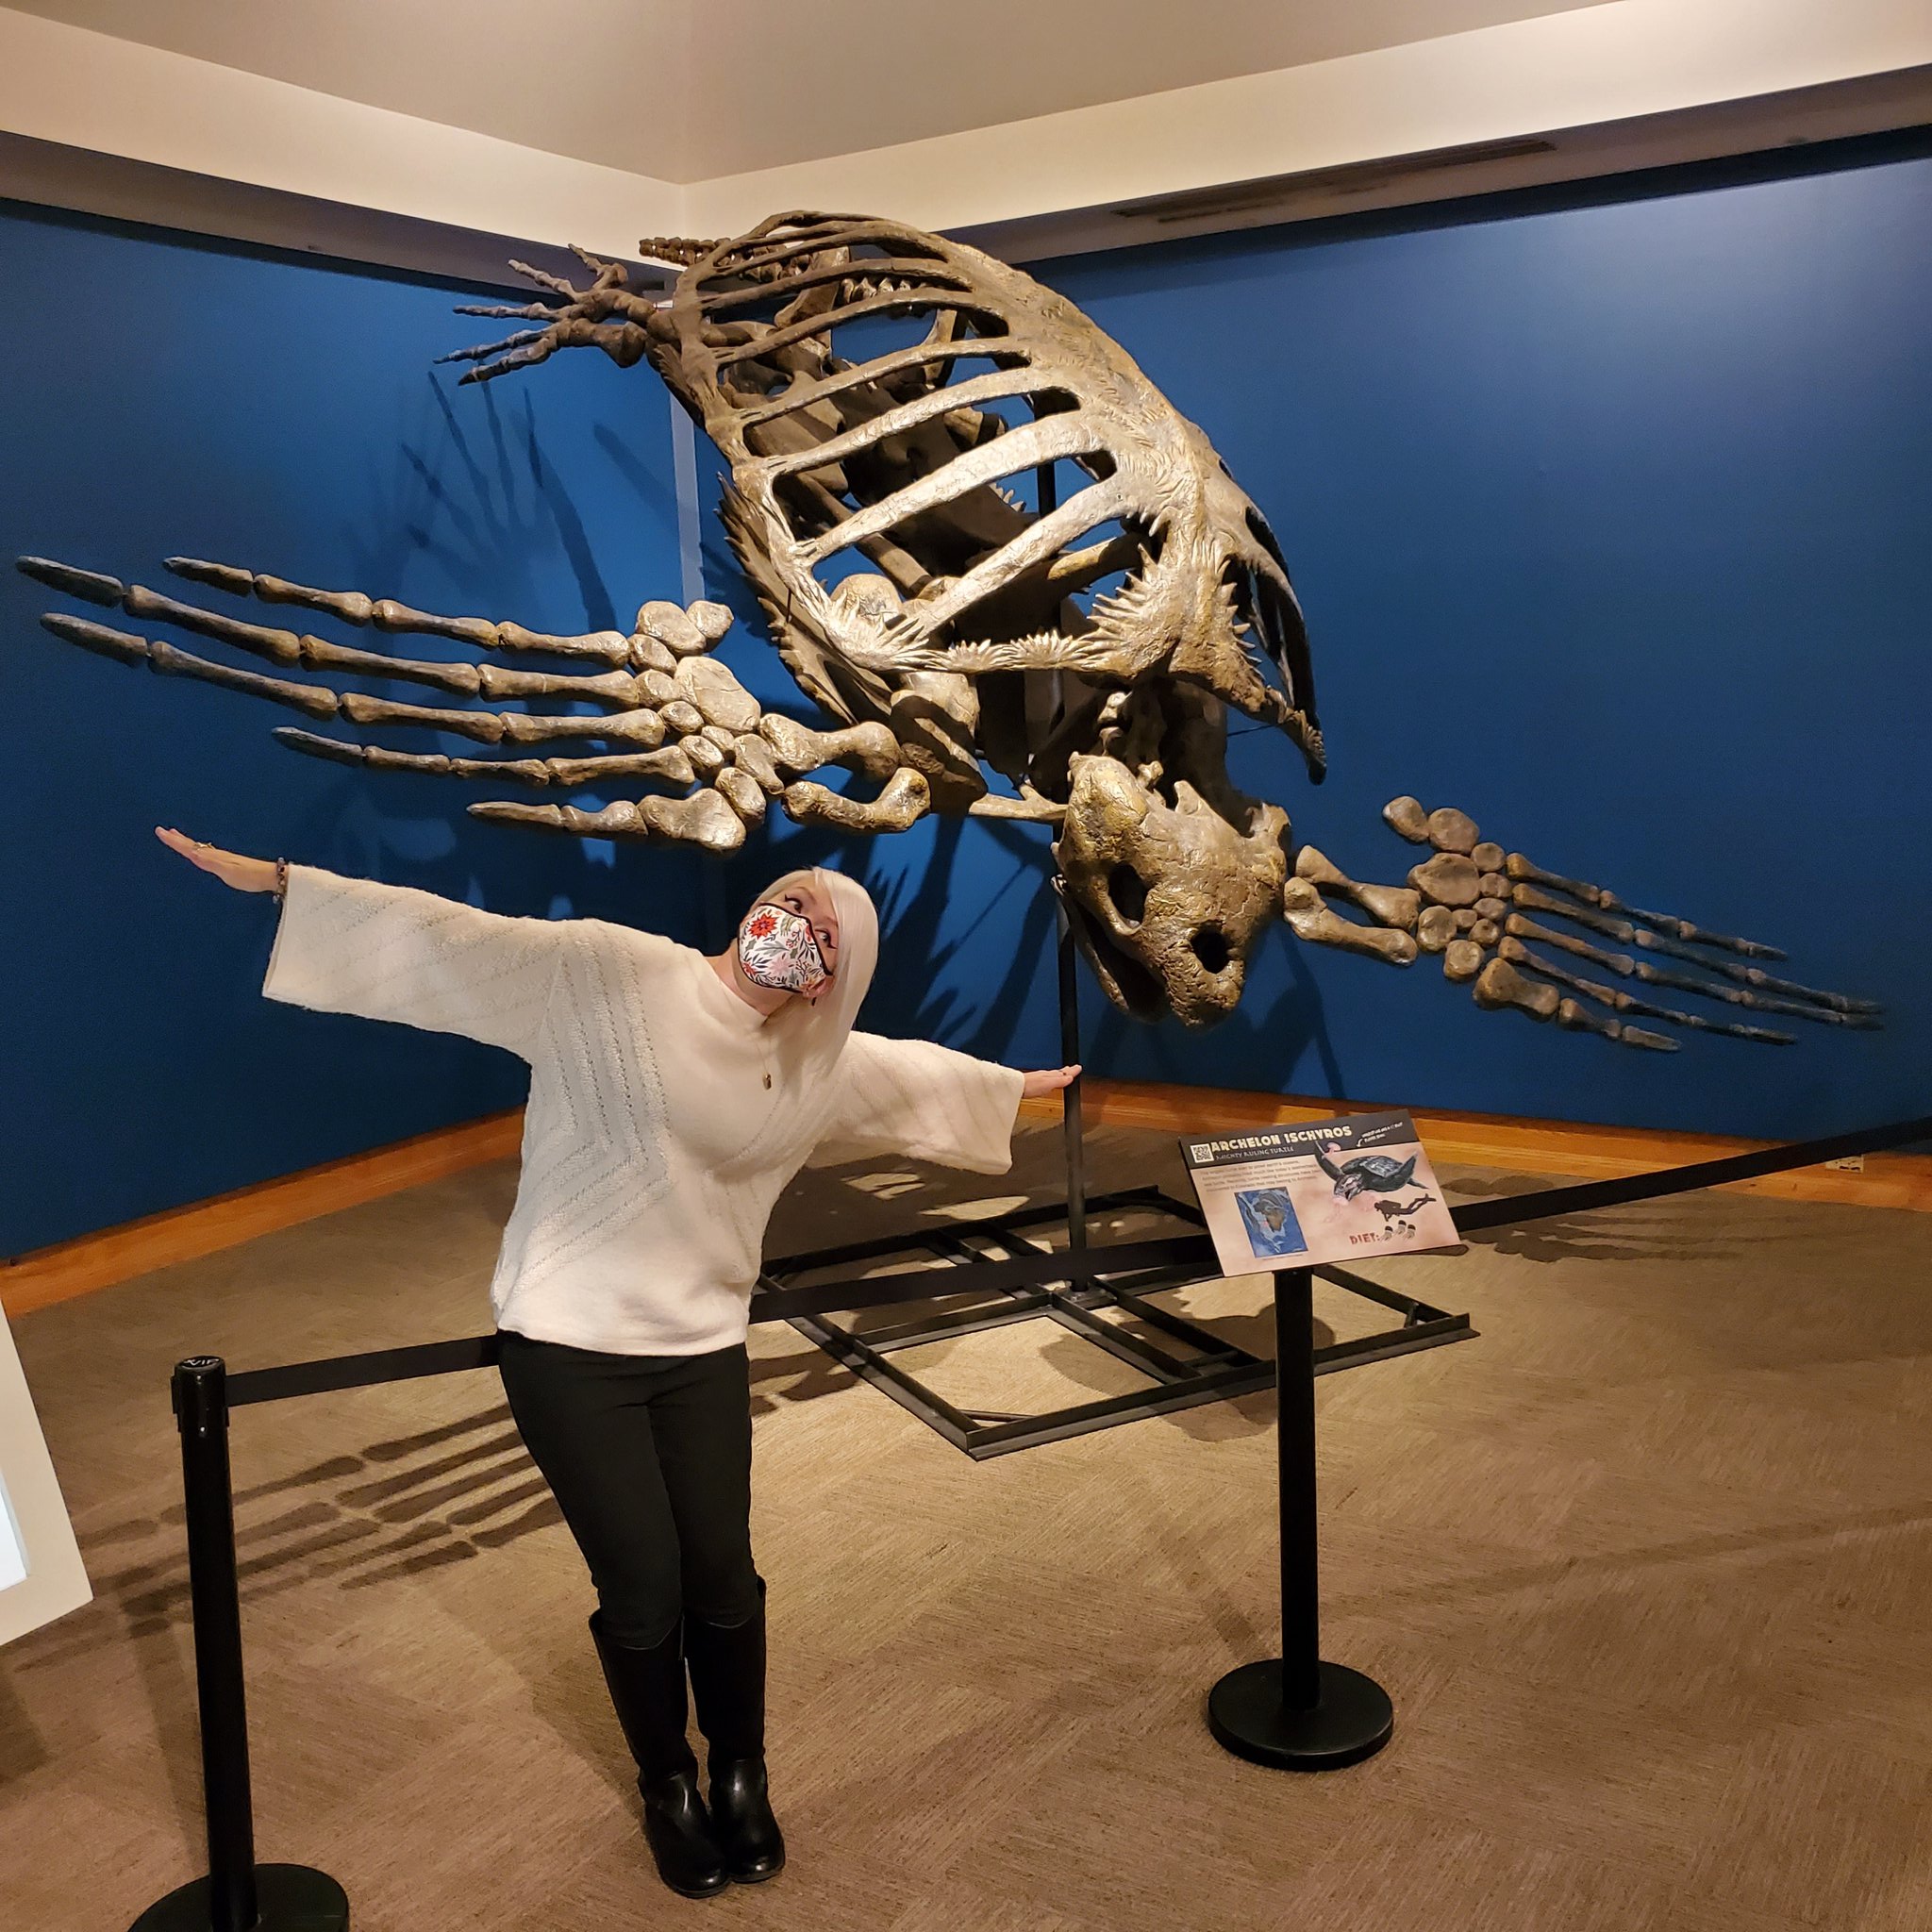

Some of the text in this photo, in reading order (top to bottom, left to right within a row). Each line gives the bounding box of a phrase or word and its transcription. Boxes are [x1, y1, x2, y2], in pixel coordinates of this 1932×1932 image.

[1210, 1134, 1281, 1152] ARCHELON
[1284, 1125, 1353, 1144] ISCHYROS
[1243, 1148, 1270, 1158] RULING
[1270, 1145, 1294, 1154] TURTLE
[1349, 1232, 1380, 1245] DIET:
